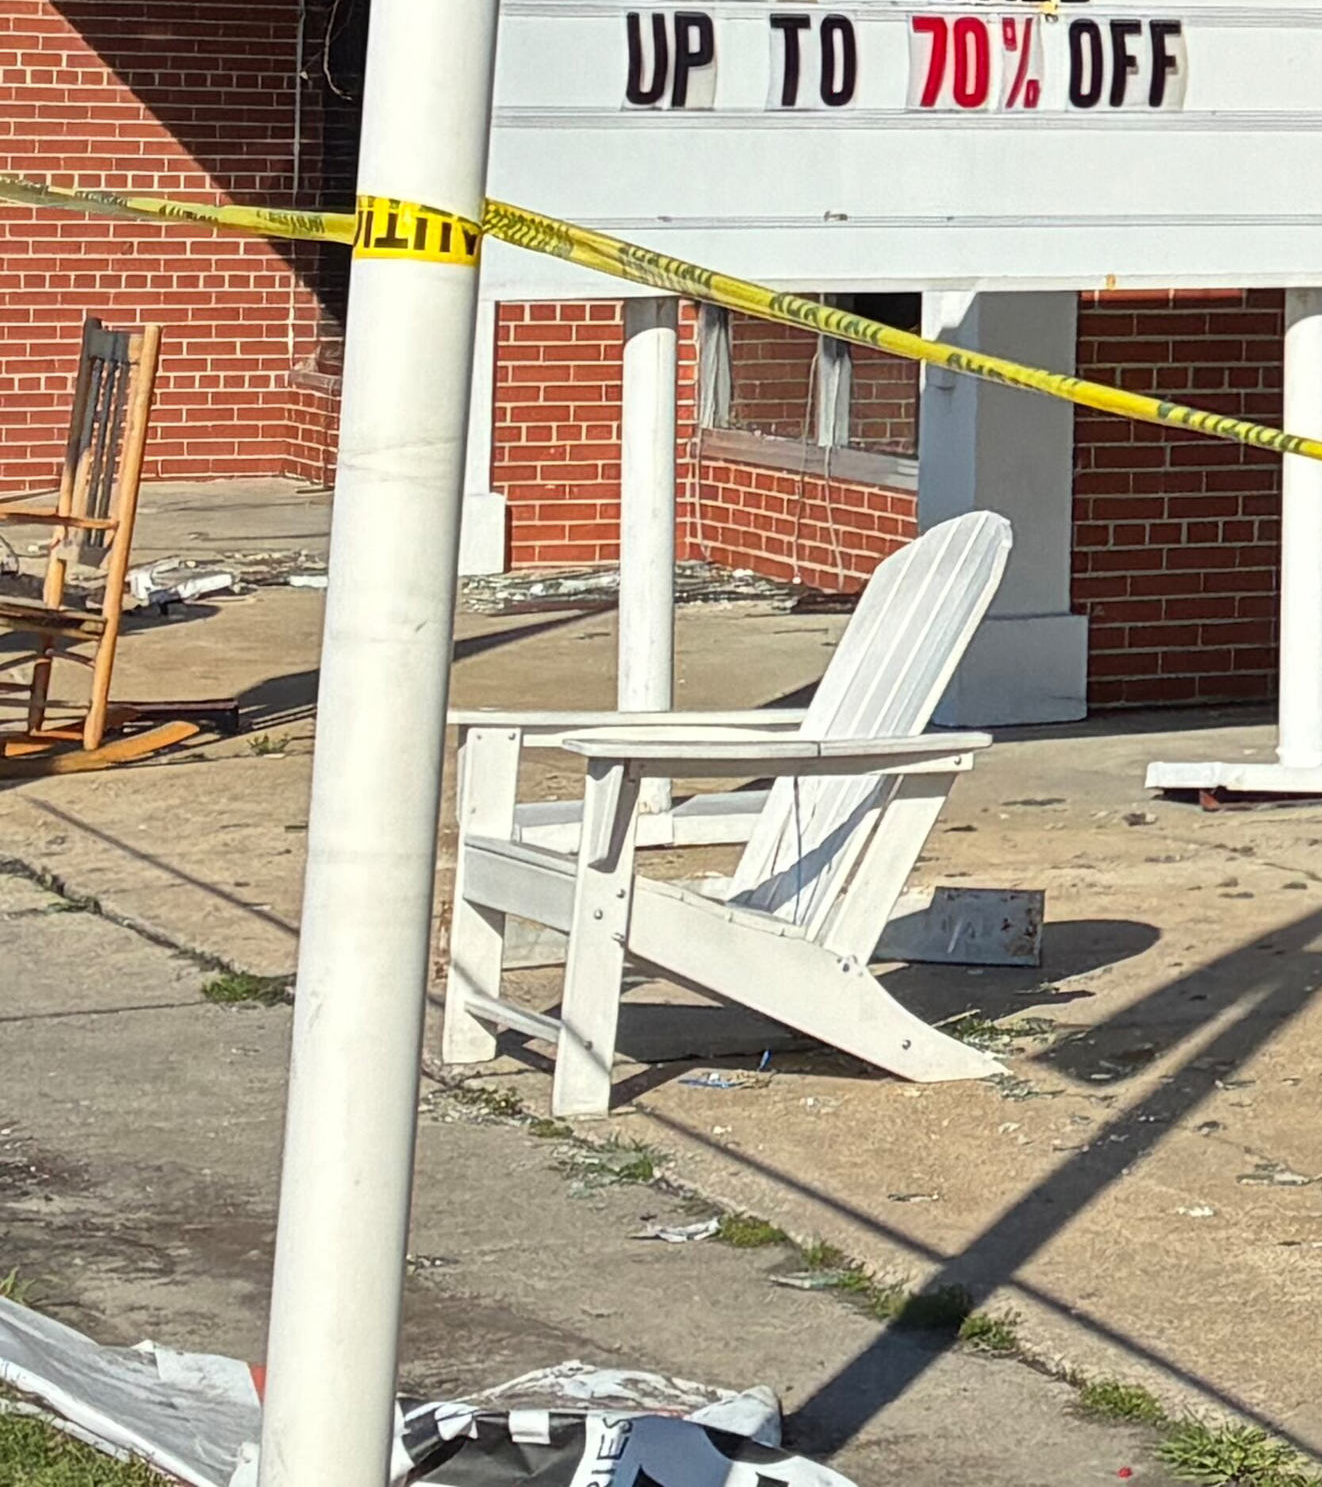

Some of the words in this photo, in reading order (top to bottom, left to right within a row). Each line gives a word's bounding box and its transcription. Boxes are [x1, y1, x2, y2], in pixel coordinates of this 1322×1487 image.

[625, 11, 714, 106] UP
[770, 13, 858, 107] TO
[912, 14, 1040, 110] 70%
[1068, 17, 1183, 109] OFF
